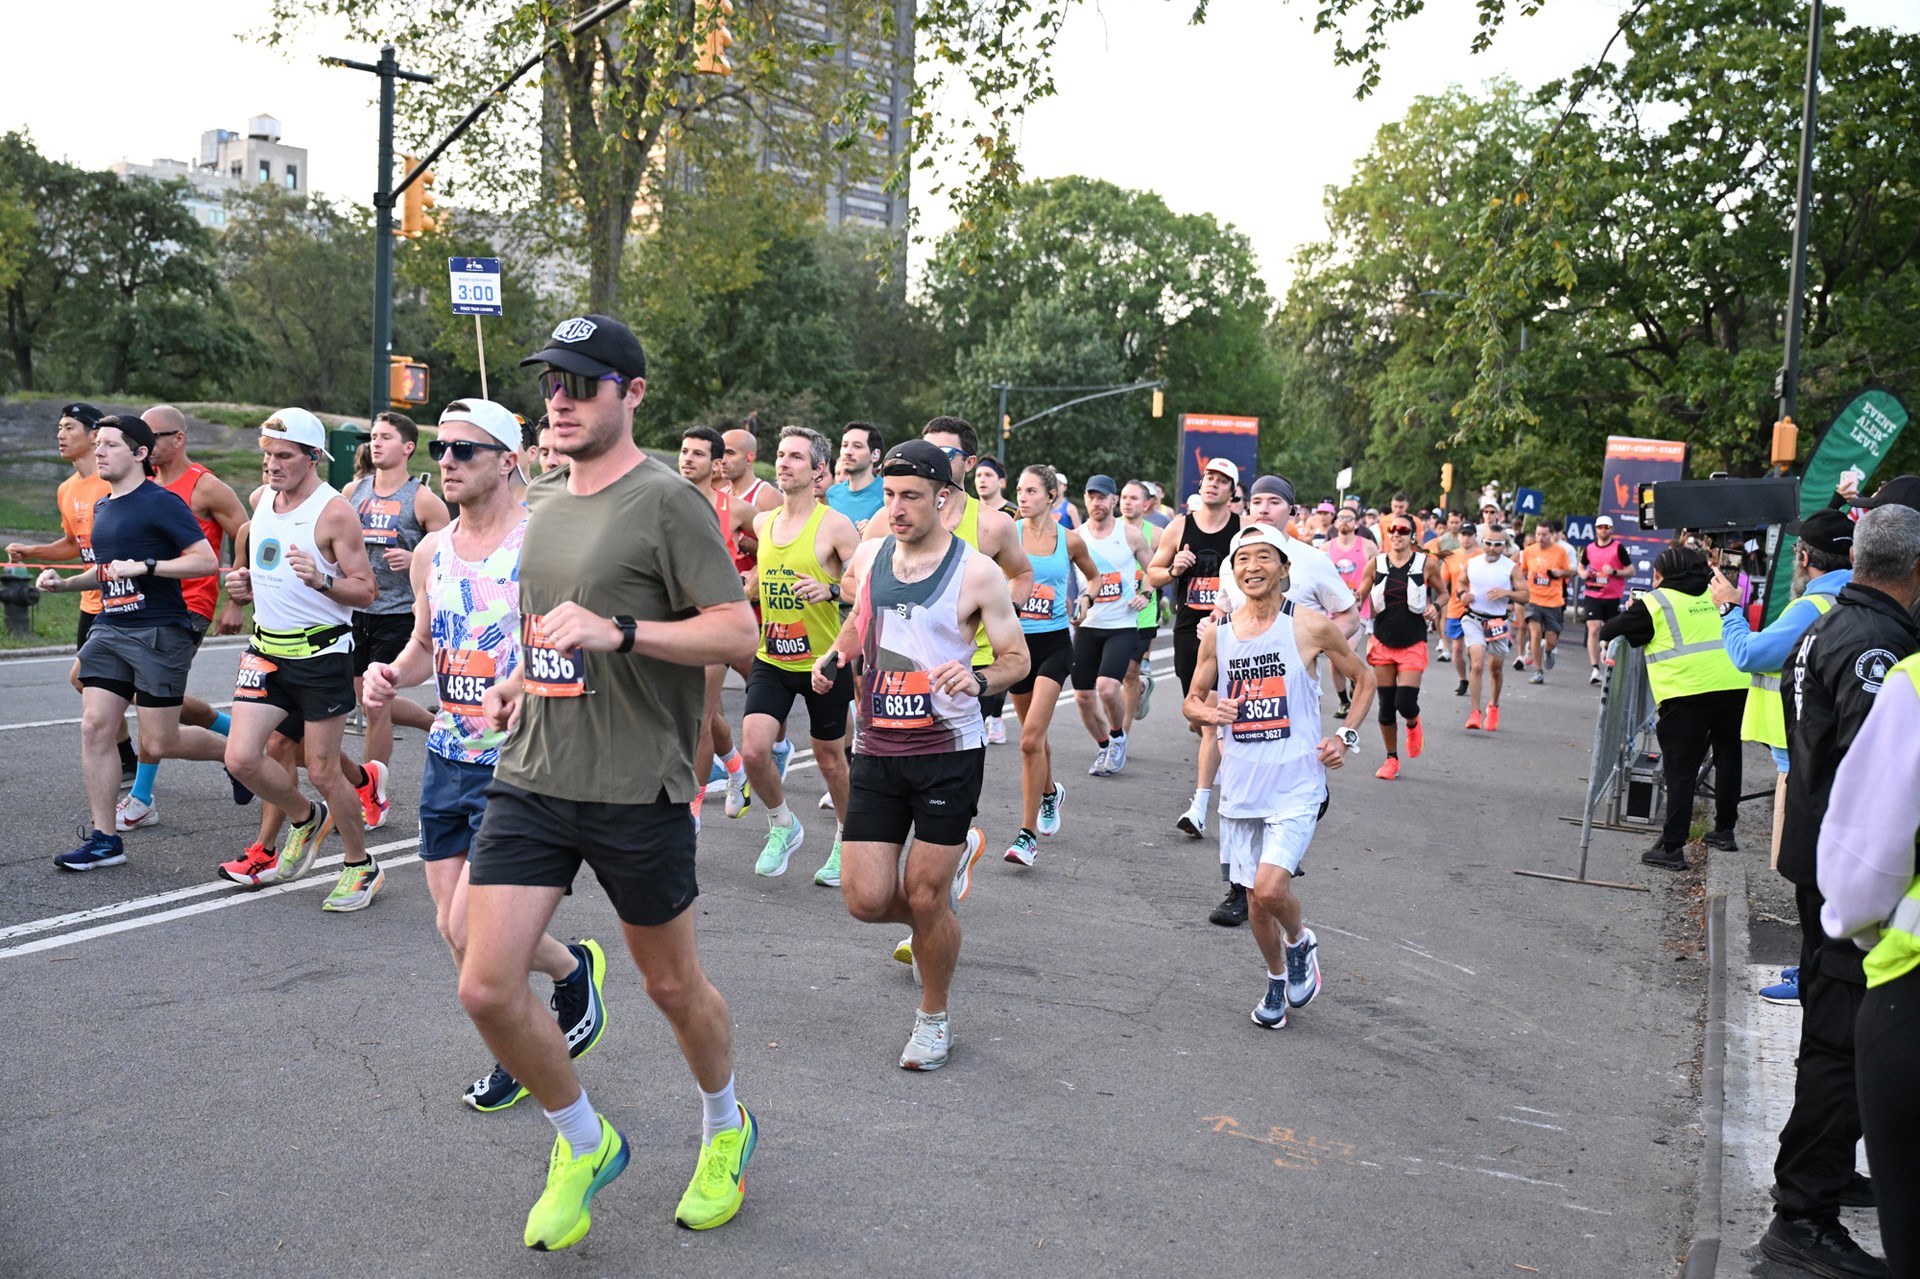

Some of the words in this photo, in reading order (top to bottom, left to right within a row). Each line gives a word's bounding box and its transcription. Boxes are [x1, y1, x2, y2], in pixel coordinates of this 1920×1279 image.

[458, 285, 494, 301] 3:00
[556, 320, 591, 340] DEUS
[1186, 418, 1208, 426] START
[1211, 419, 1232, 428] START
[1235, 421, 1256, 429] START
[1862, 401, 1897, 434] EVENT
[1522, 494, 1535, 510] A
[370, 513, 392, 528] 317
[1567, 522, 1595, 540] AA
[107, 577, 135, 597] 2474
[1099, 583, 1120, 597] 1826
[769, 597, 805, 610] KIDS
[1022, 598, 1050, 613] 1842
[776, 637, 806, 654] 6005
[531, 647, 575, 680] 5636
[1229, 657, 1251, 670] NEW
[1253, 651, 1281, 667] YORK
[235, 669, 262, 688] 5615
[447, 675, 486, 702] 4835
[885, 694, 926, 716] 6812
[1245, 697, 1281, 720] 3627
[1245, 732, 1265, 740] CHECK
[1264, 729, 1282, 740] 3627
